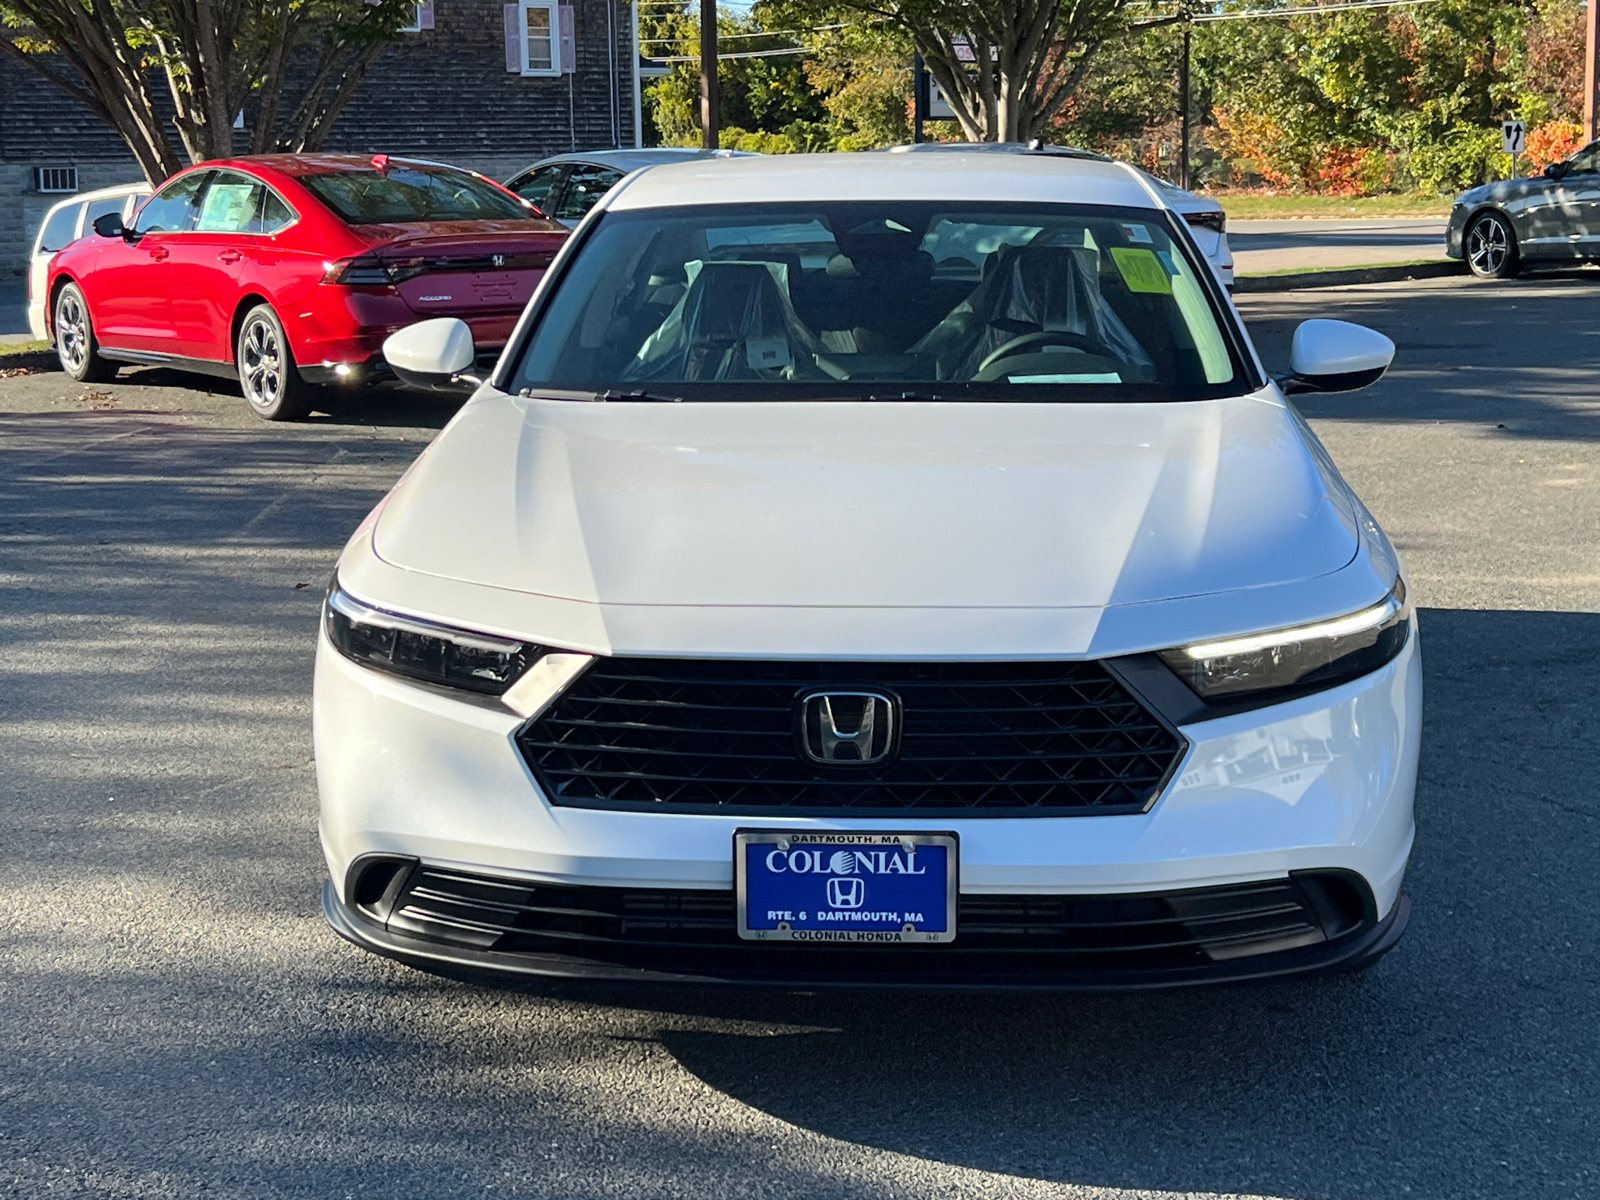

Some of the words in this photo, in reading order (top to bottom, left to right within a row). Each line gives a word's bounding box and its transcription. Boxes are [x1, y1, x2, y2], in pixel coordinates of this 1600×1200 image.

[791, 835, 877, 844] DARTMOUTH,
[881, 836, 901, 844] MA
[766, 850, 926, 875] COLONIAL
[767, 910, 796, 921] RTE.
[799, 911, 807, 921] 6
[817, 911, 901, 923] DARTMOUTH,
[904, 912, 924, 922] MA
[791, 930, 853, 941] COLONIAL
[857, 932, 902, 942] HONDA
